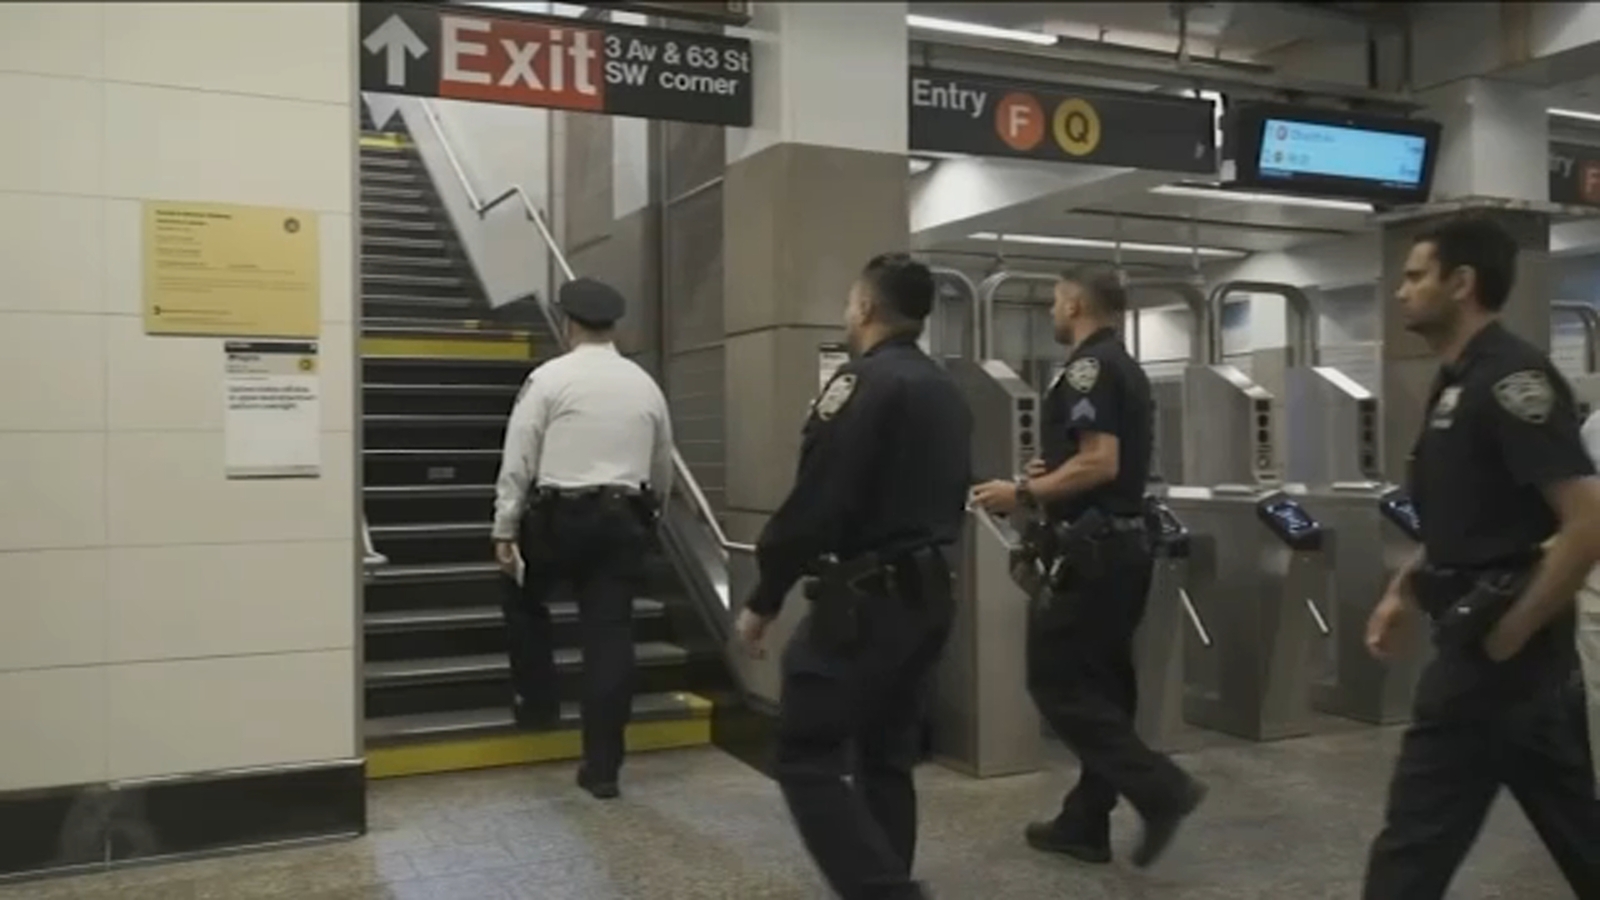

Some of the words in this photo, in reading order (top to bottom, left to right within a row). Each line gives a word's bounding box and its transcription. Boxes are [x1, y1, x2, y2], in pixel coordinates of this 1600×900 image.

[440, 16, 598, 96] Exit
[604, 36, 622, 59] 3
[626, 39, 658, 62] Av
[663, 41, 681, 65] &
[686, 45, 719, 70] 63
[723, 49, 750, 73] St
[604, 61, 649, 86] SW
[659, 71, 740, 96] corner
[911, 78, 987, 118] Entry
[1008, 104, 1031, 138] F
[1064, 110, 1089, 144] Q
